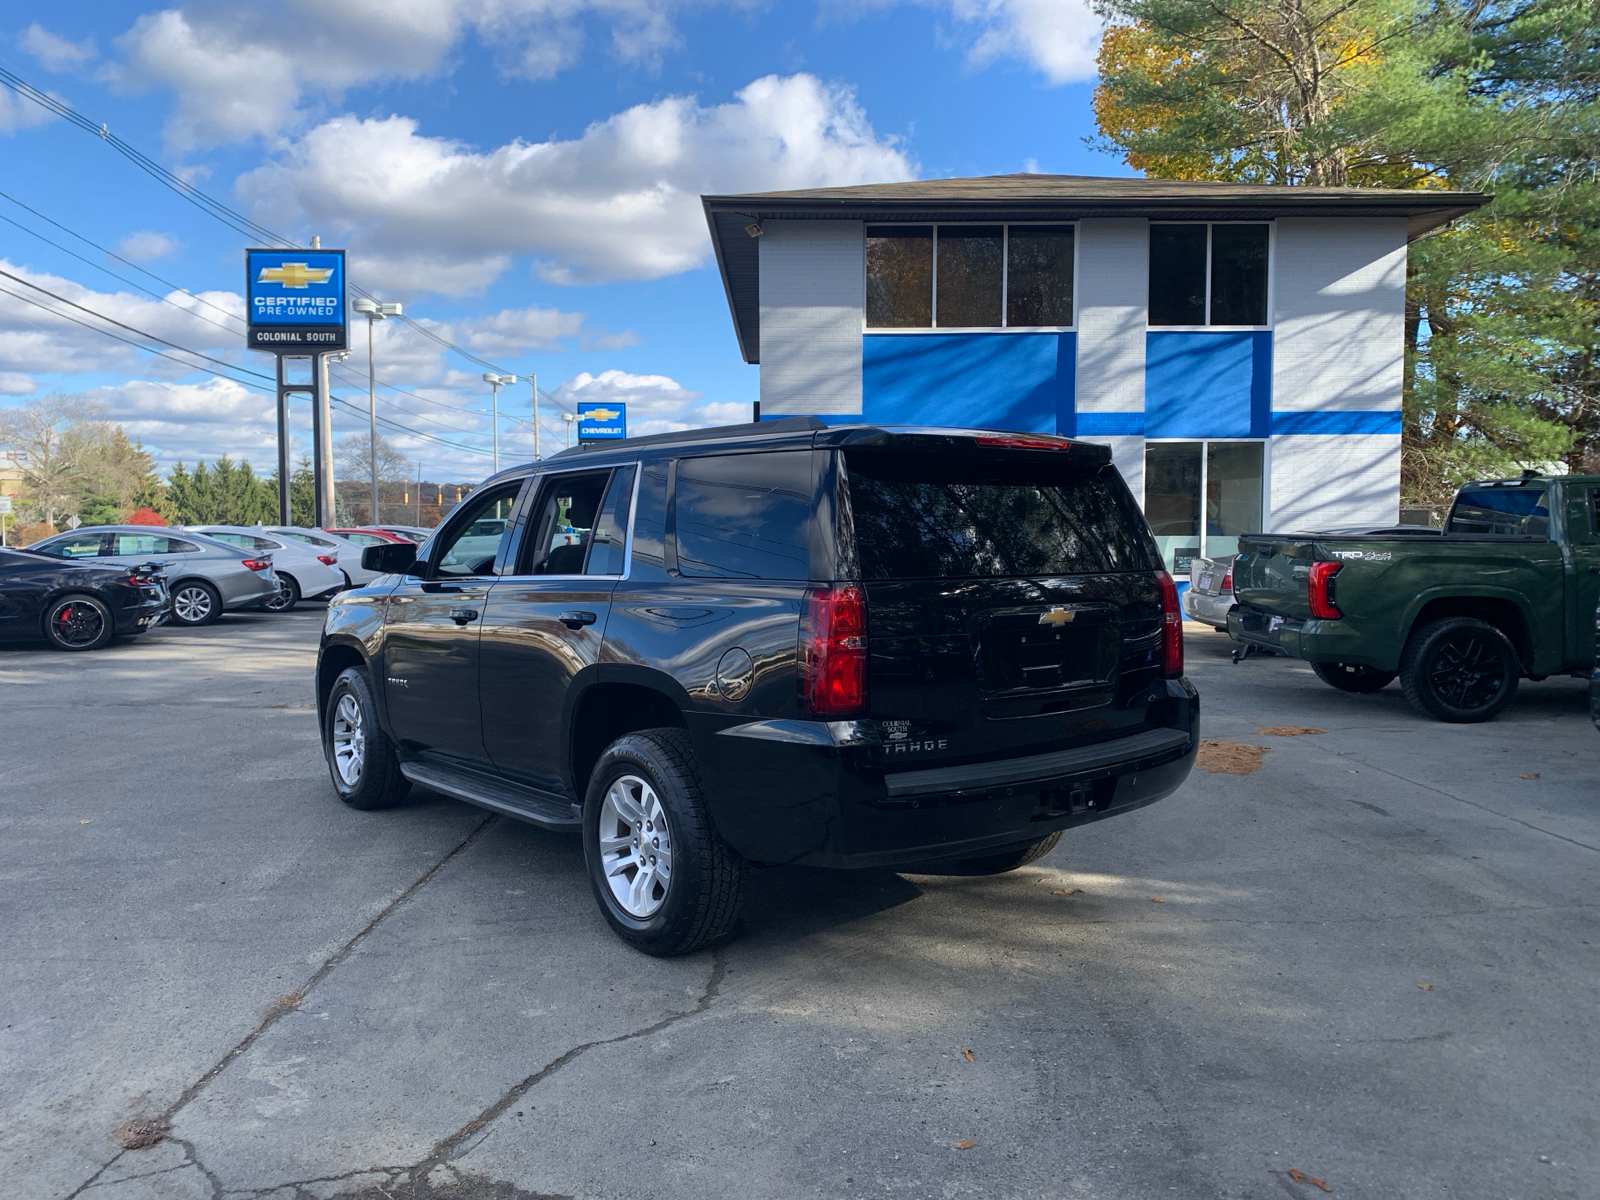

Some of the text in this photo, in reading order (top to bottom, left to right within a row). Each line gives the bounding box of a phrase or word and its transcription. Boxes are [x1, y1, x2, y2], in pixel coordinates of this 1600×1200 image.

[254, 297, 337, 306] CERTIFIED
[258, 307, 334, 315] PRE-OWNED
[257, 332, 336, 341] COLONIAL SOUTH
[1331, 551, 1363, 560] TRD
[387, 677, 409, 688] TAHOE
[882, 719, 912, 728] COLONIAL
[882, 740, 948, 754] TAHOE
